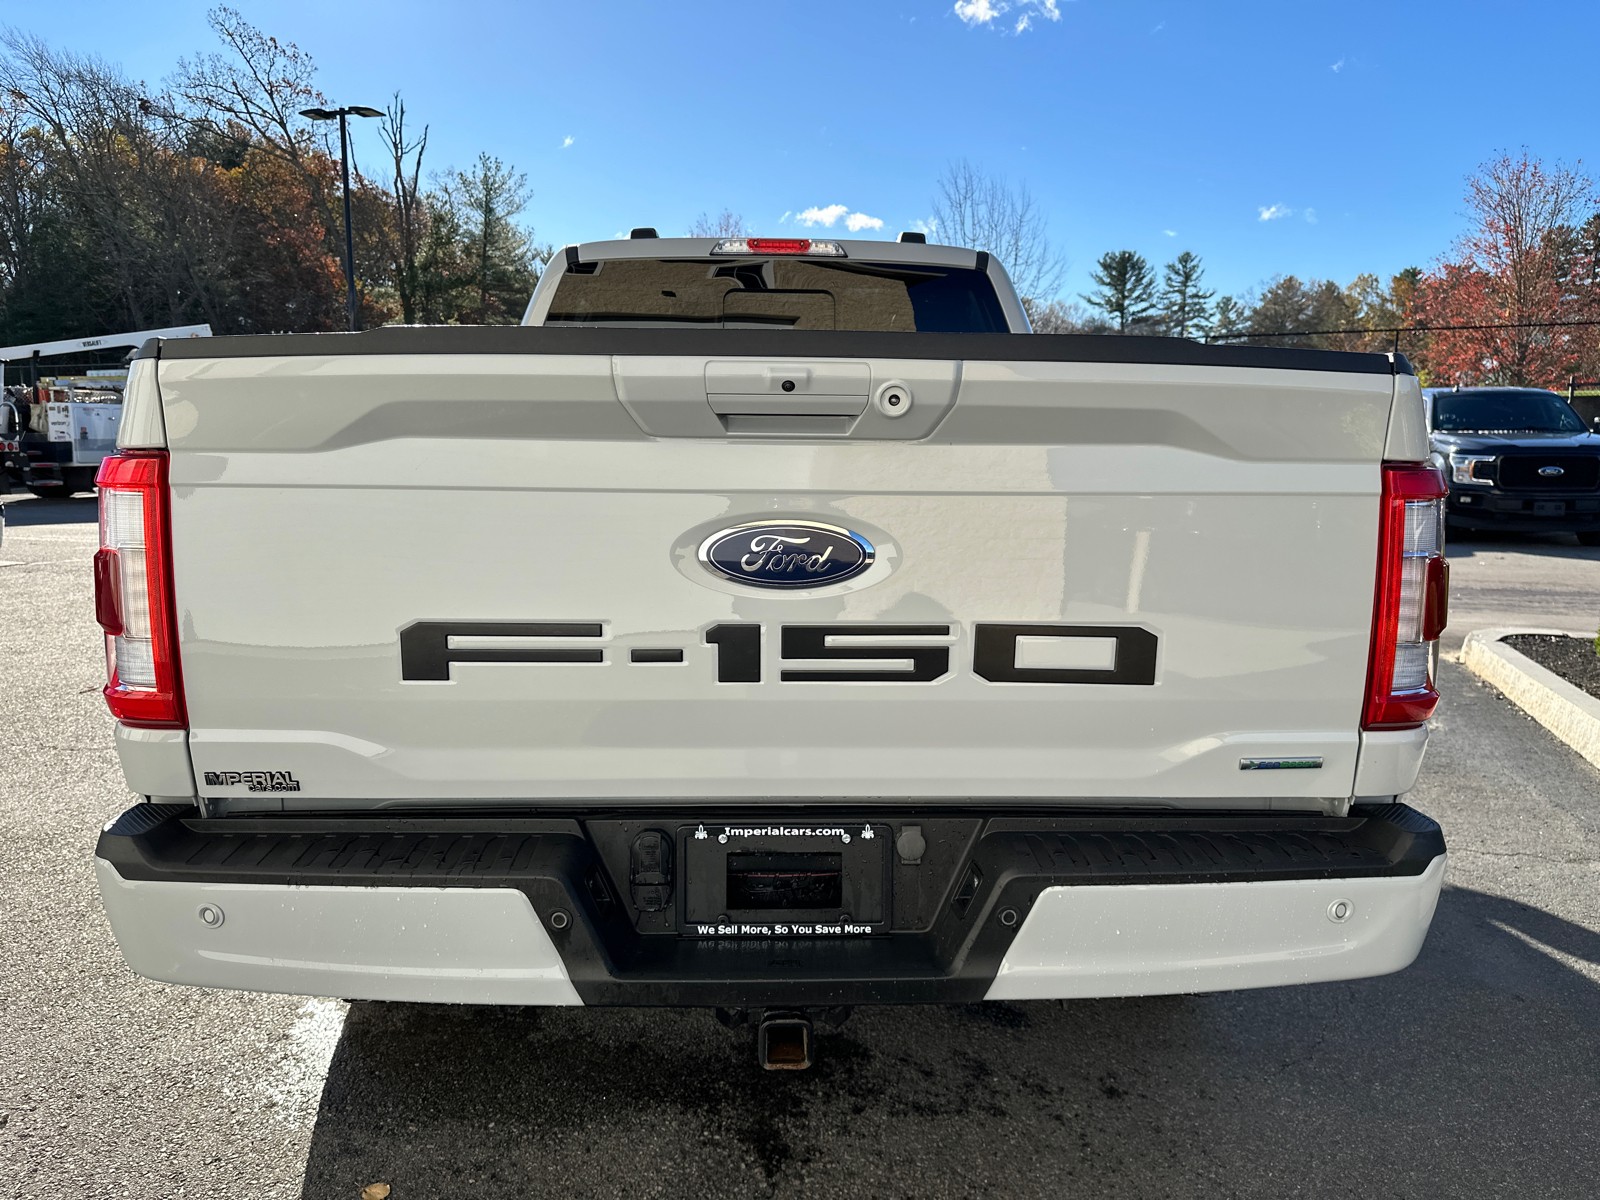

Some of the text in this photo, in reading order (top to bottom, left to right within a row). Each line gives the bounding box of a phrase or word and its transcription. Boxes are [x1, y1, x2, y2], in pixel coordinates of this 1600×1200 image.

[741, 535, 833, 573] Ford
[401, 622, 1158, 685] F-150
[204, 771, 299, 785] IMPERIAL
[724, 826, 845, 838] Imperialcars.com
[697, 924, 872, 935] We Sell More, So You Save More
